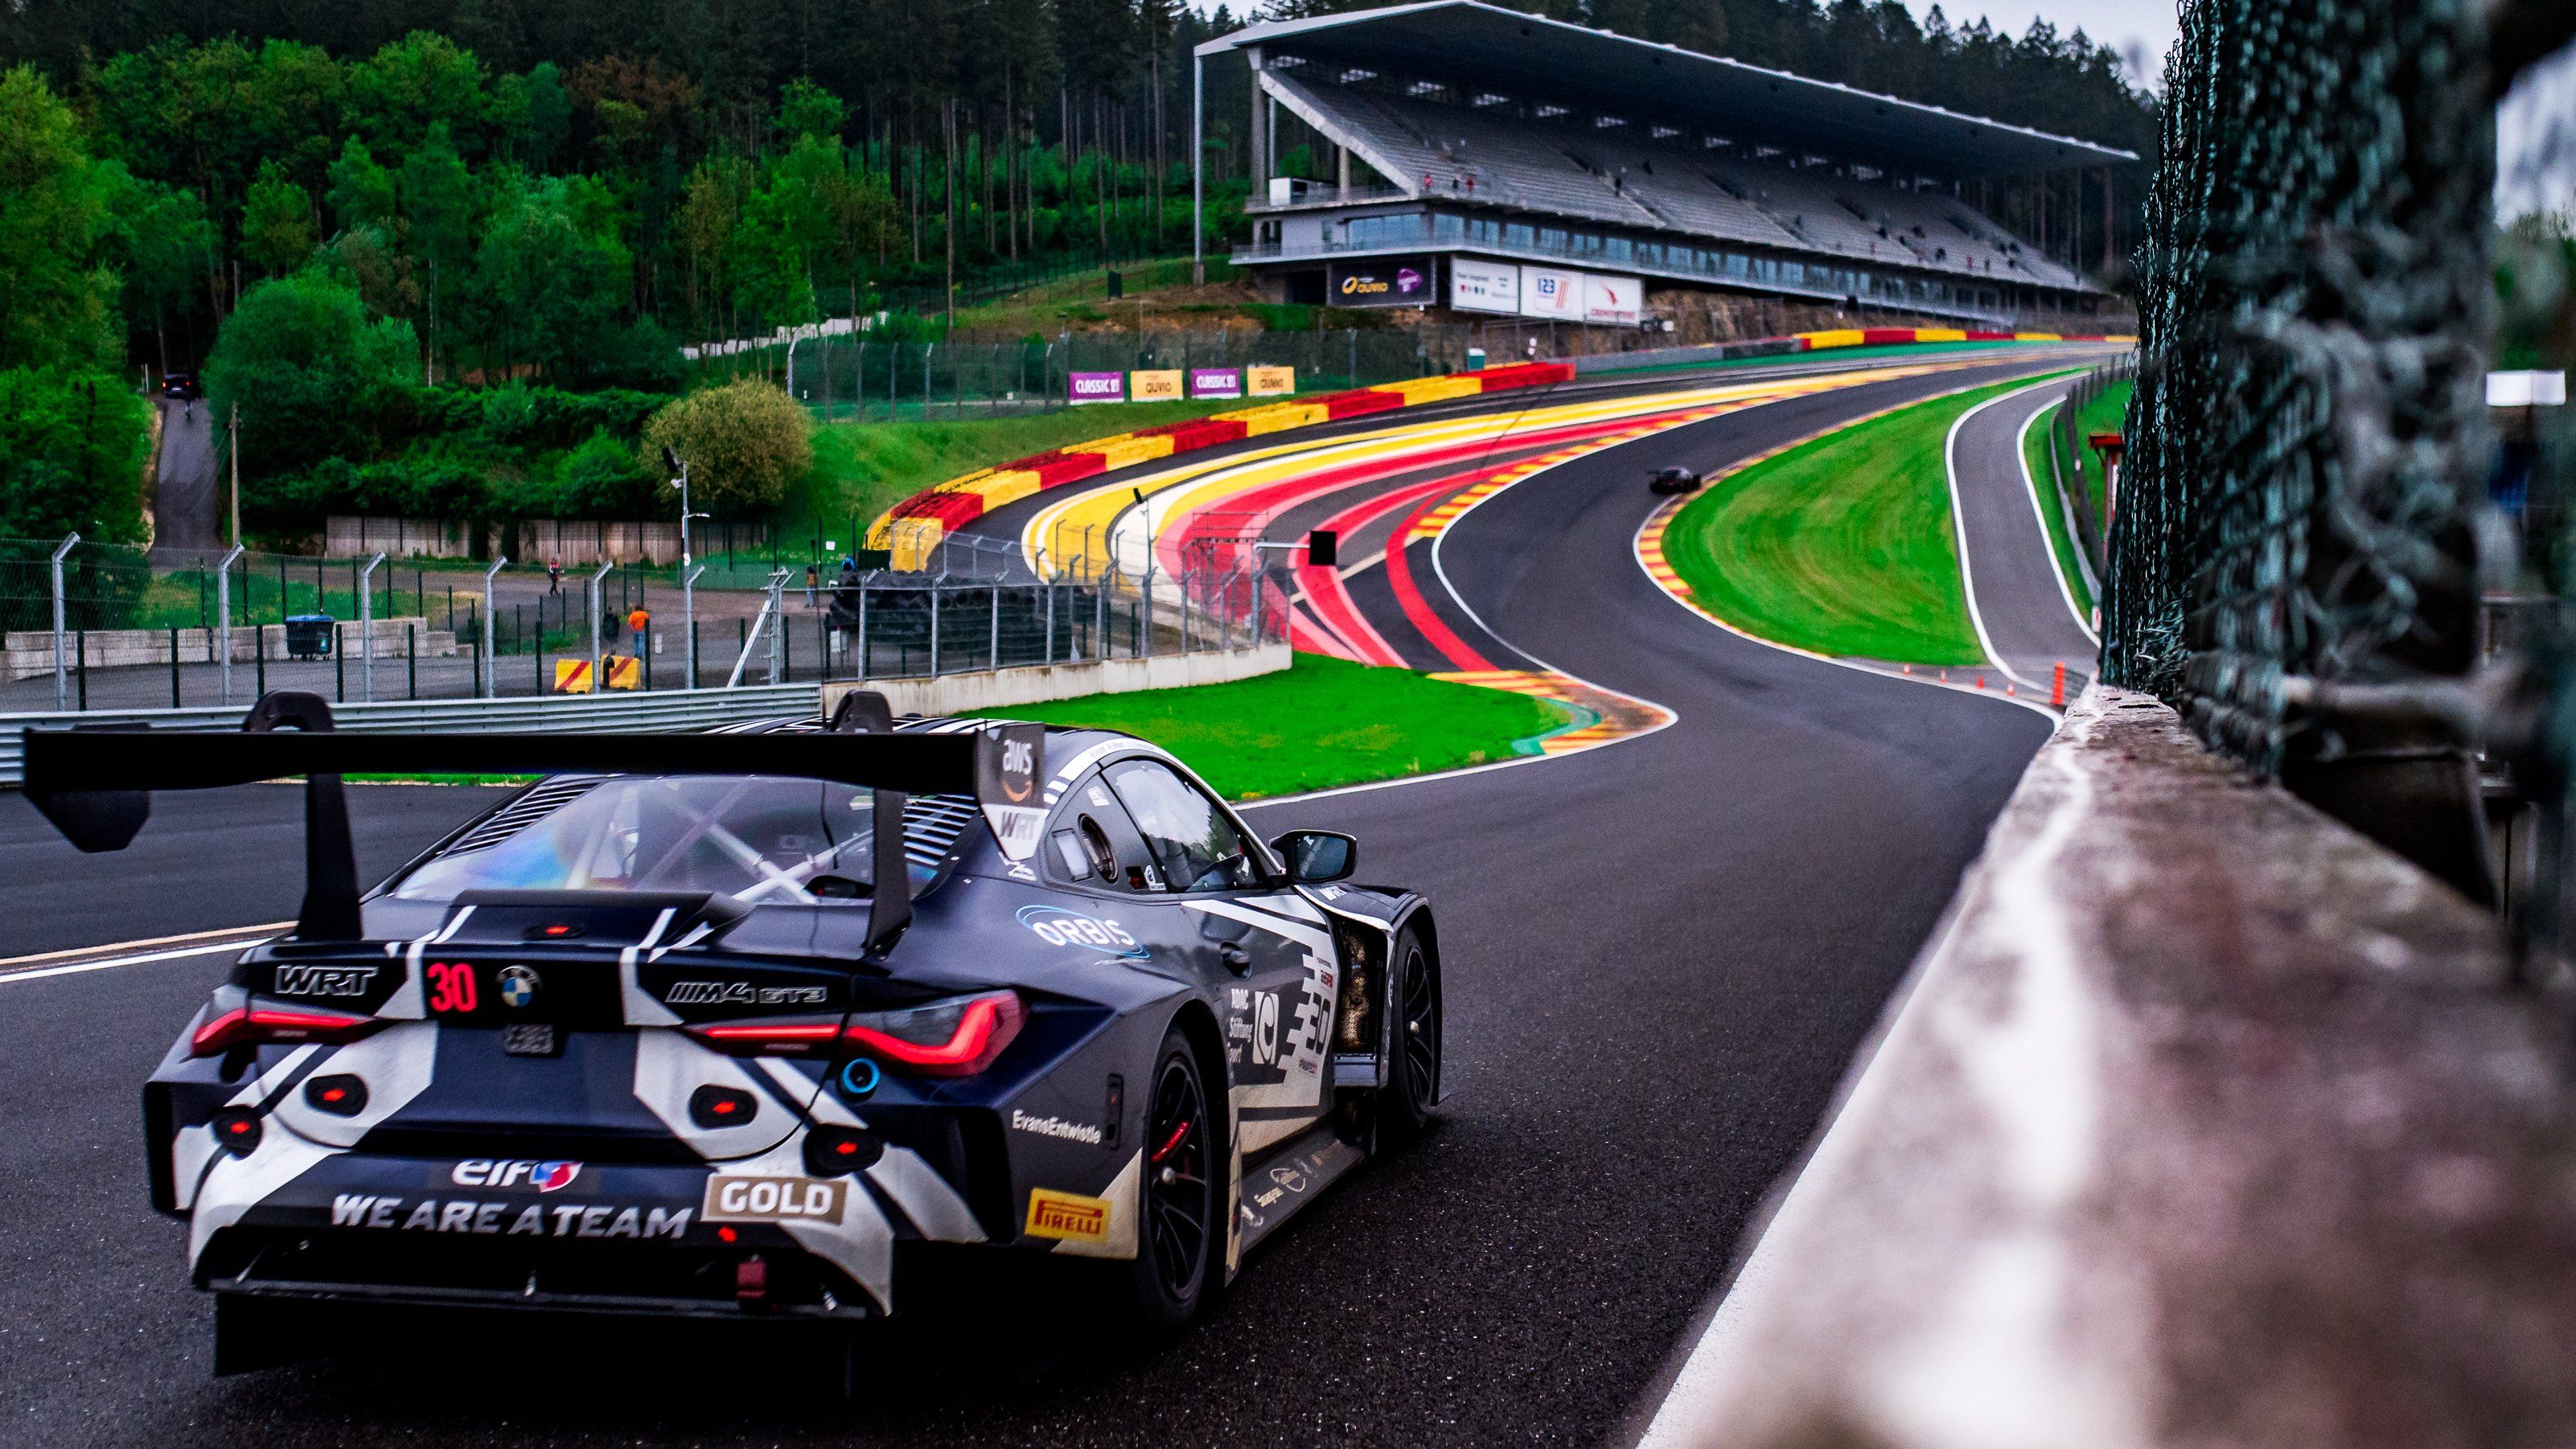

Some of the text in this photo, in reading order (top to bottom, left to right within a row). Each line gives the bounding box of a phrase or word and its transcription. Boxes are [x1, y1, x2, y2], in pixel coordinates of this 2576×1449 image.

[1074, 379, 1109, 393] CLASSIC
[1002, 739, 1033, 775] aws
[999, 811, 1039, 841] WRT
[1033, 918, 1135, 946] ORBIS
[273, 964, 379, 996] WRT
[427, 962, 479, 1013] 30
[452, 1159, 535, 1187] elf
[719, 1180, 834, 1216] GOLD
[331, 1193, 695, 1239] WE ARE A TEAM
[1033, 1199, 1103, 1236] PIRELLI
